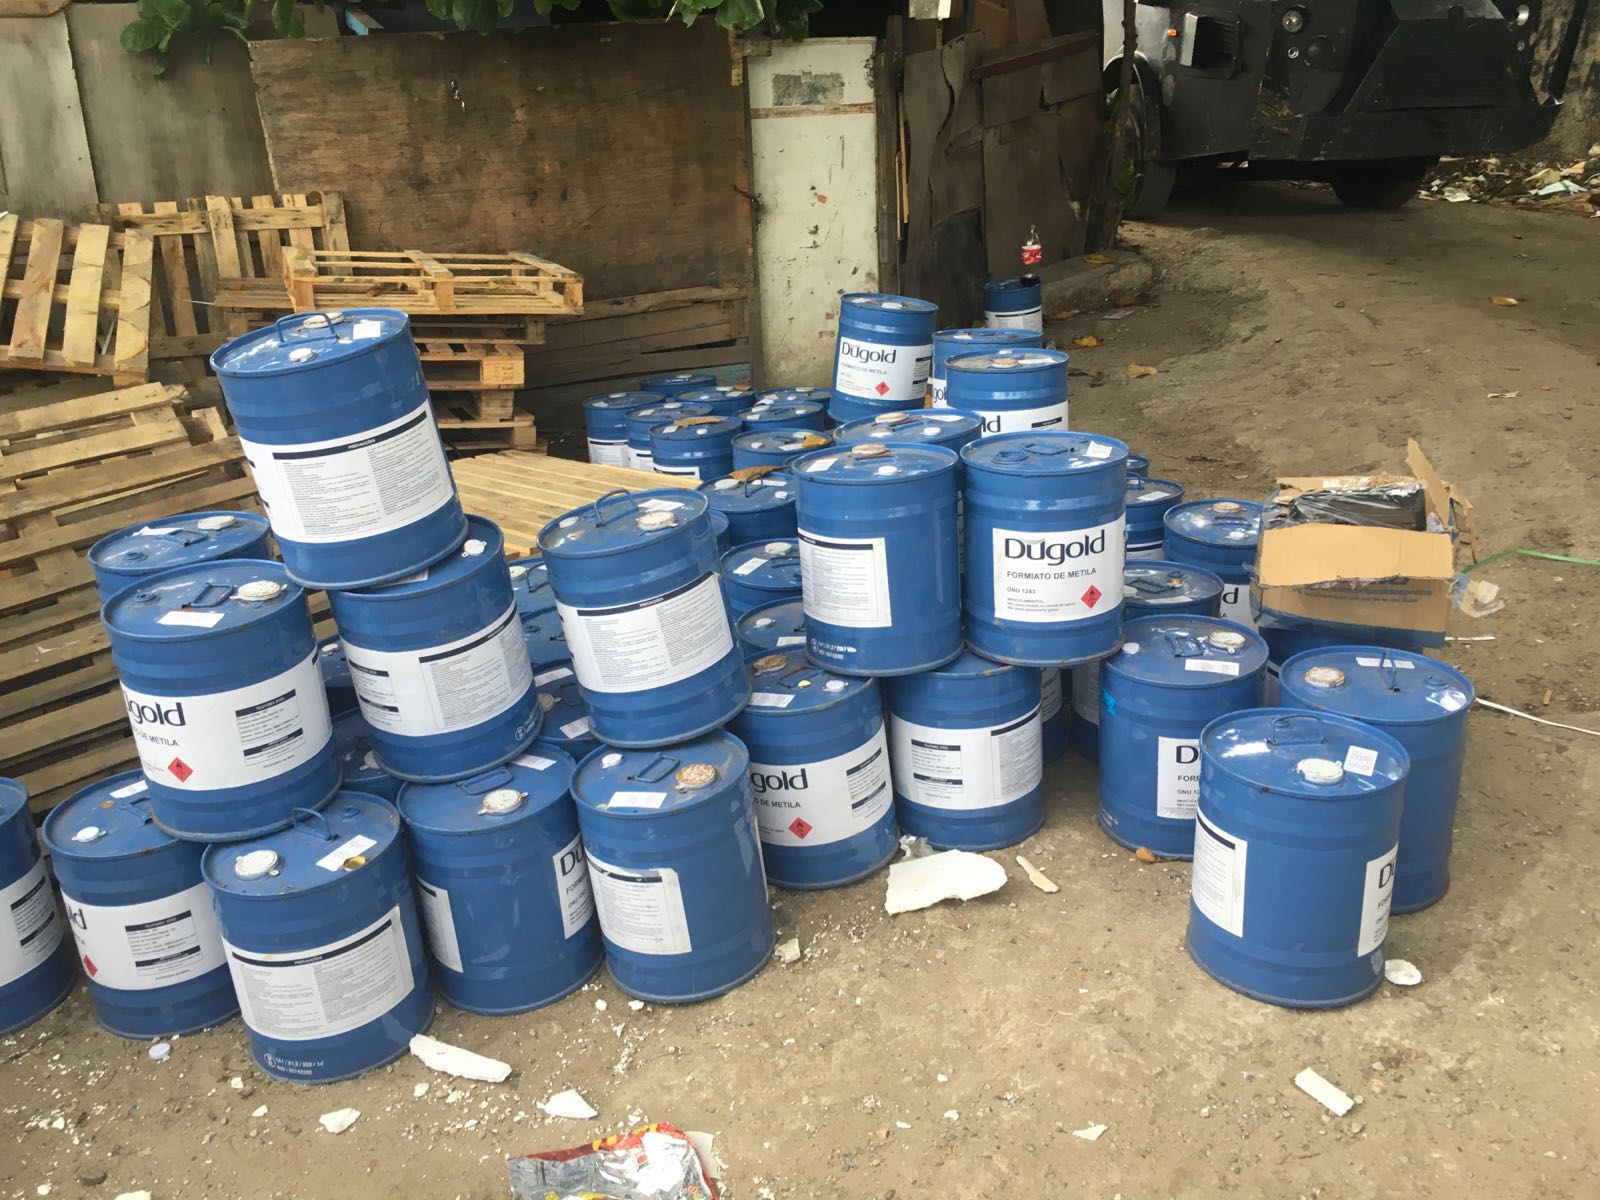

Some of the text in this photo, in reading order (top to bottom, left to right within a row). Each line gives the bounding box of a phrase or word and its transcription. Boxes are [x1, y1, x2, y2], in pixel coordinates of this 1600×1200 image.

[1007, 567, 1097, 580] FORMIATO DE METILA
[1007, 586, 1020, 594] ONU
[149, 735, 179, 747] METILA
[750, 768, 809, 793] gold
[771, 801, 802, 809] METILA
